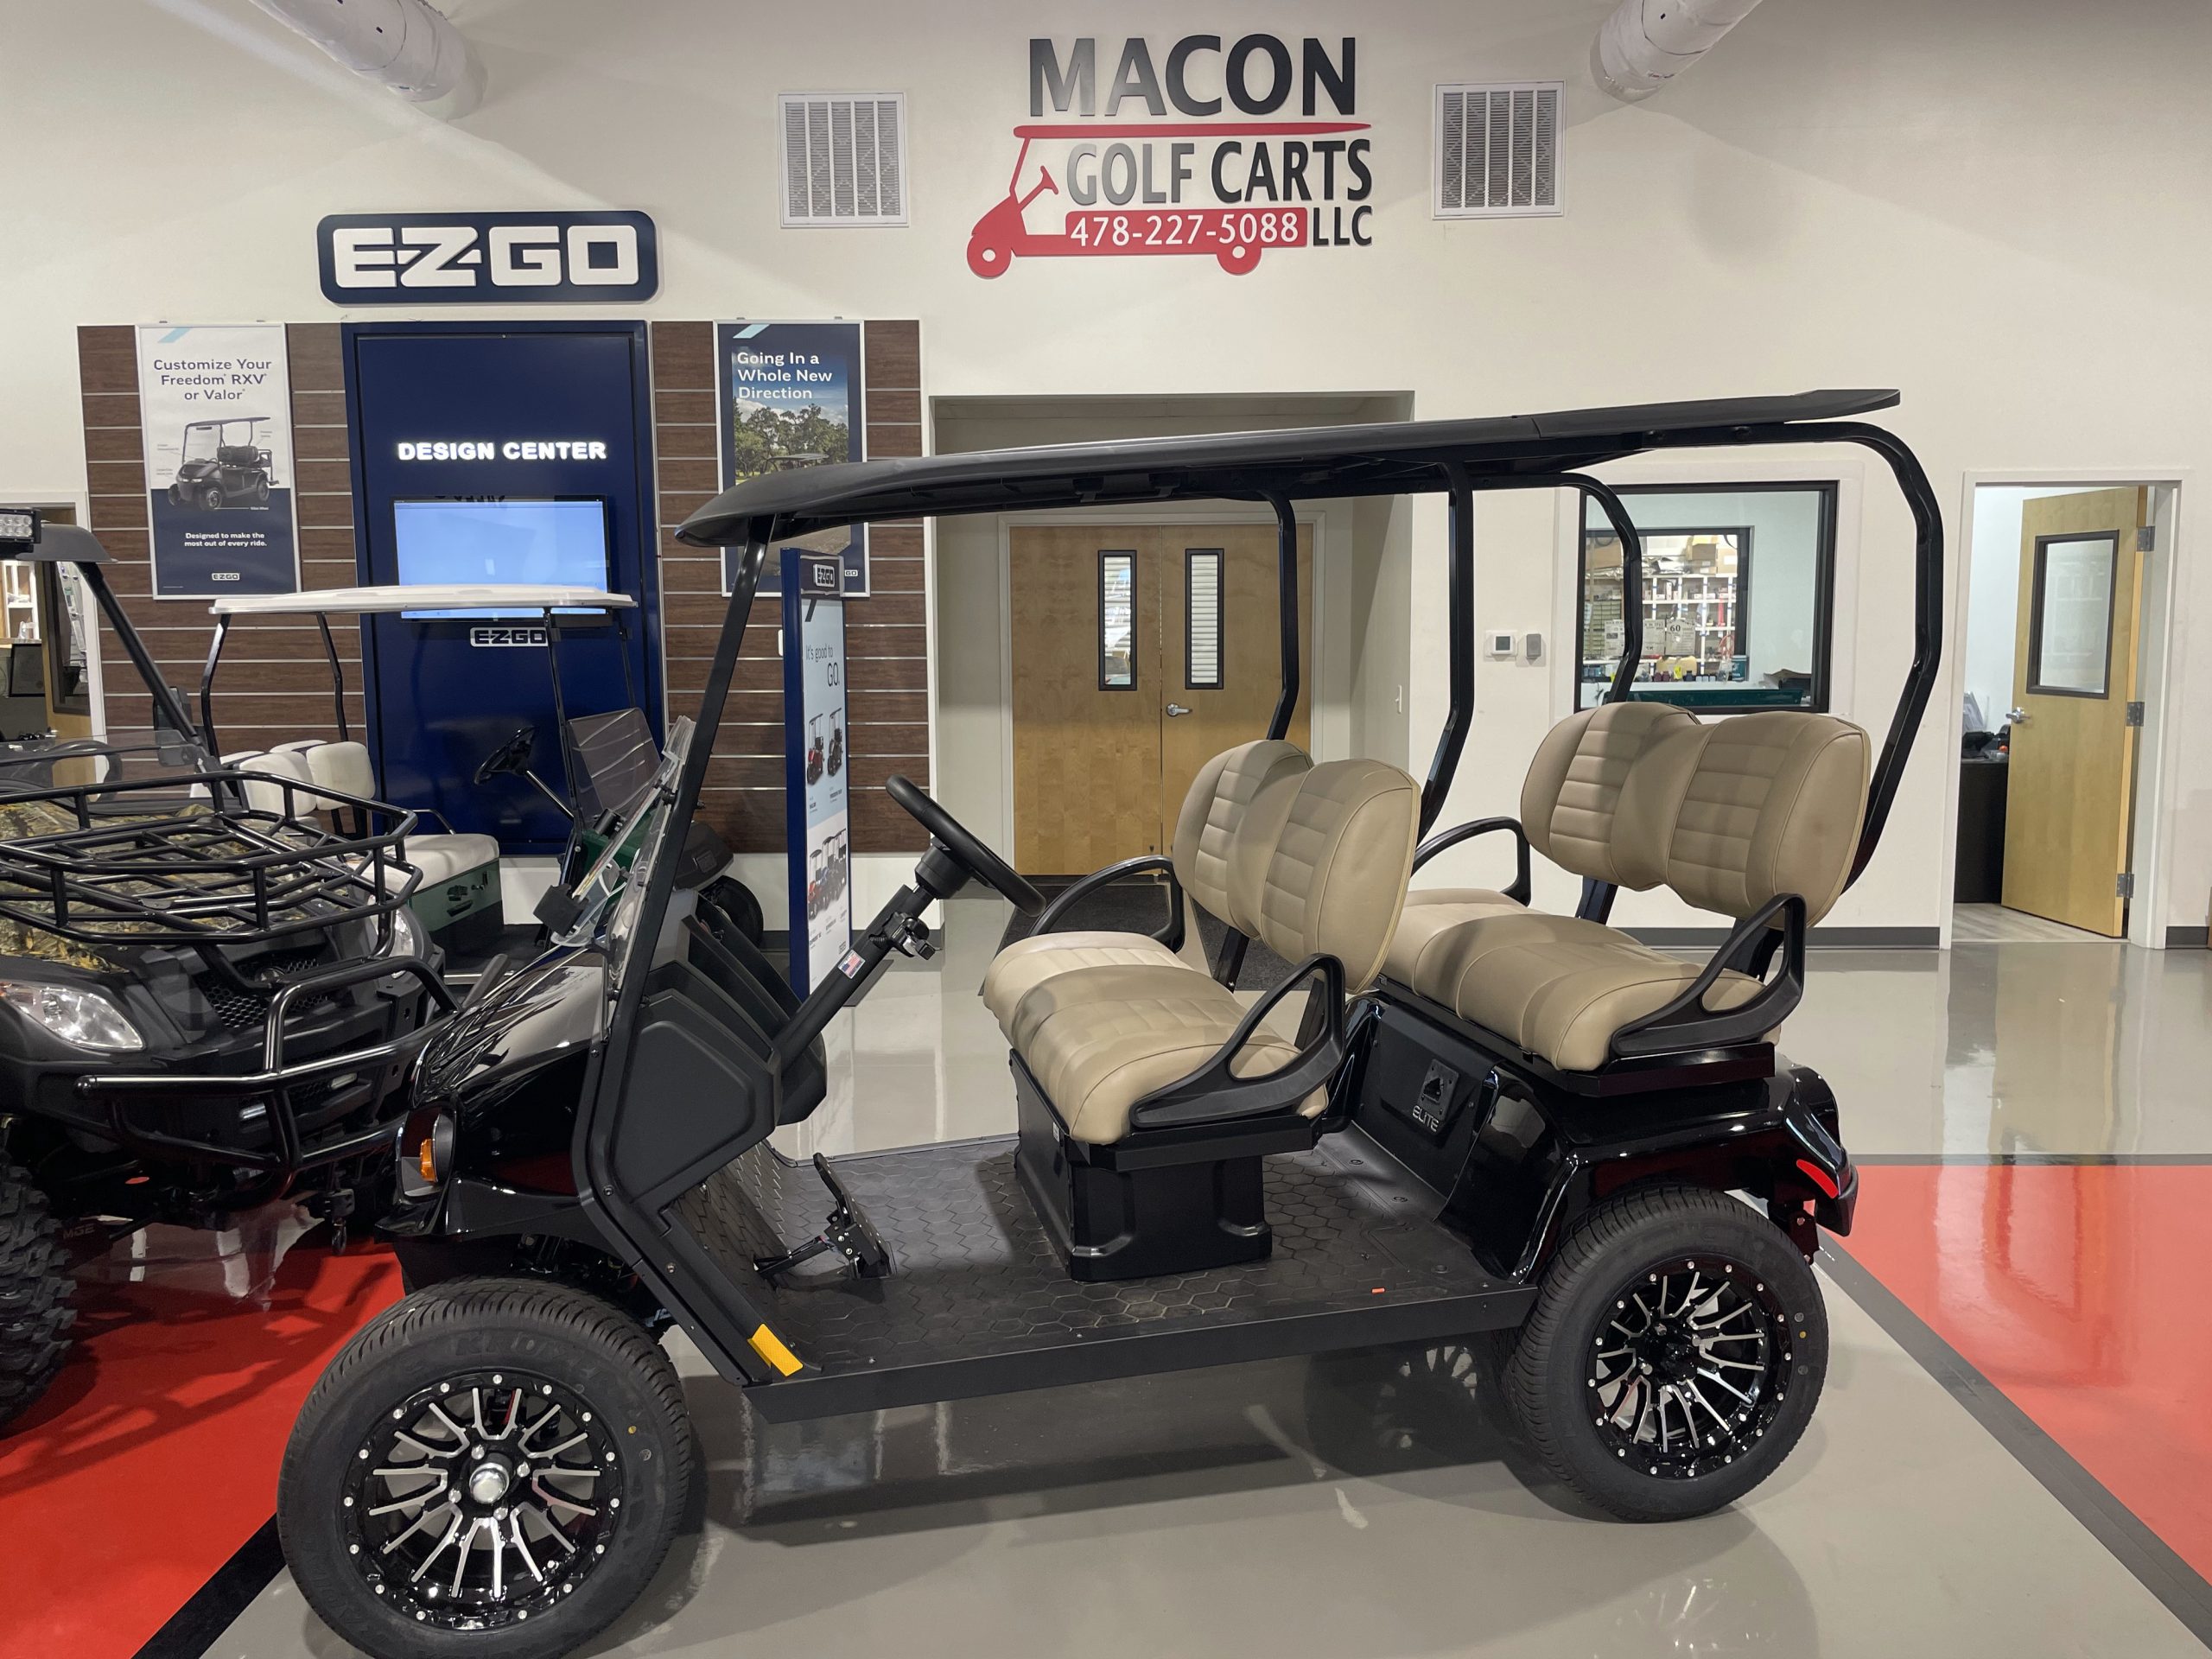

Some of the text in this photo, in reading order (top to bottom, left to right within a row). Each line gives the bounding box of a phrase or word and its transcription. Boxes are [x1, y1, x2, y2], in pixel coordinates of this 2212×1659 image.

[1029, 34, 1356, 117] MACON
[1066, 139, 1372, 206] GOLF CARTS
[1071, 213, 1299, 247] 478-227-5088
[1313, 206, 1372, 246] LLC
[154, 359, 272, 371] Customize Your
[737, 352, 820, 366] Going In a
[737, 369, 833, 382] Whole New
[184, 391, 199, 400] or
[738, 386, 812, 399] Direction
[397, 442, 607, 461] DESIGN CENTER
[1669, 624, 1681, 633] 60
[805, 643, 834, 663] It's good to
